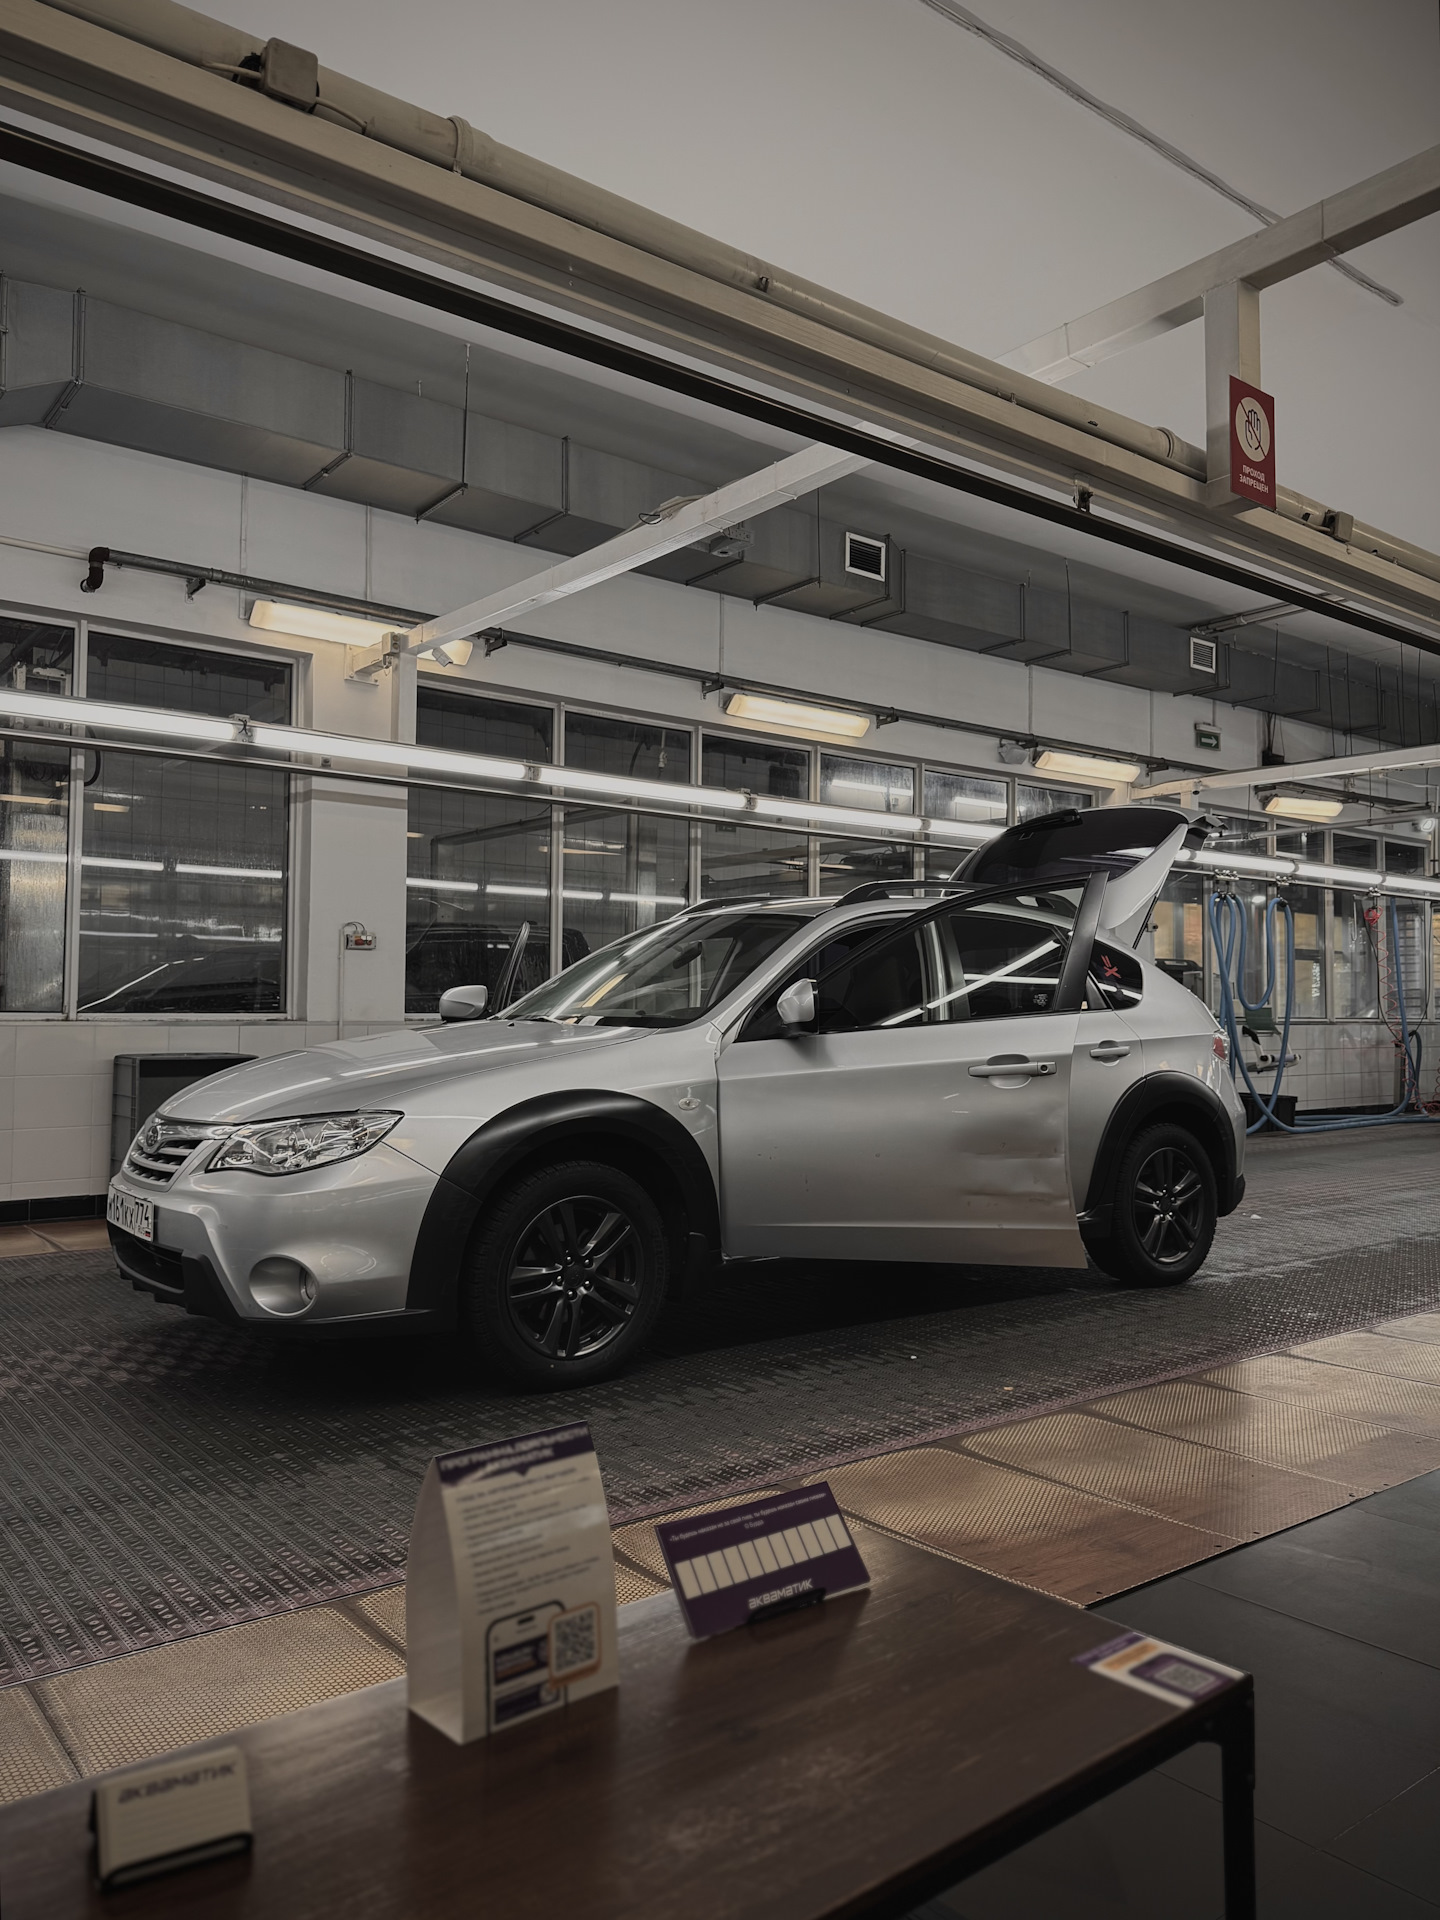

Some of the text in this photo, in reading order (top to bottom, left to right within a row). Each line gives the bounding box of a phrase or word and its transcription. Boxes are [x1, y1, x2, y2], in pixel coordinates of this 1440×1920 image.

[1239, 473, 1269, 494] ЗАПРЕЩЕН
[1242, 464, 1266, 483] ПРОХОД
[135, 1201, 151, 1228] 774
